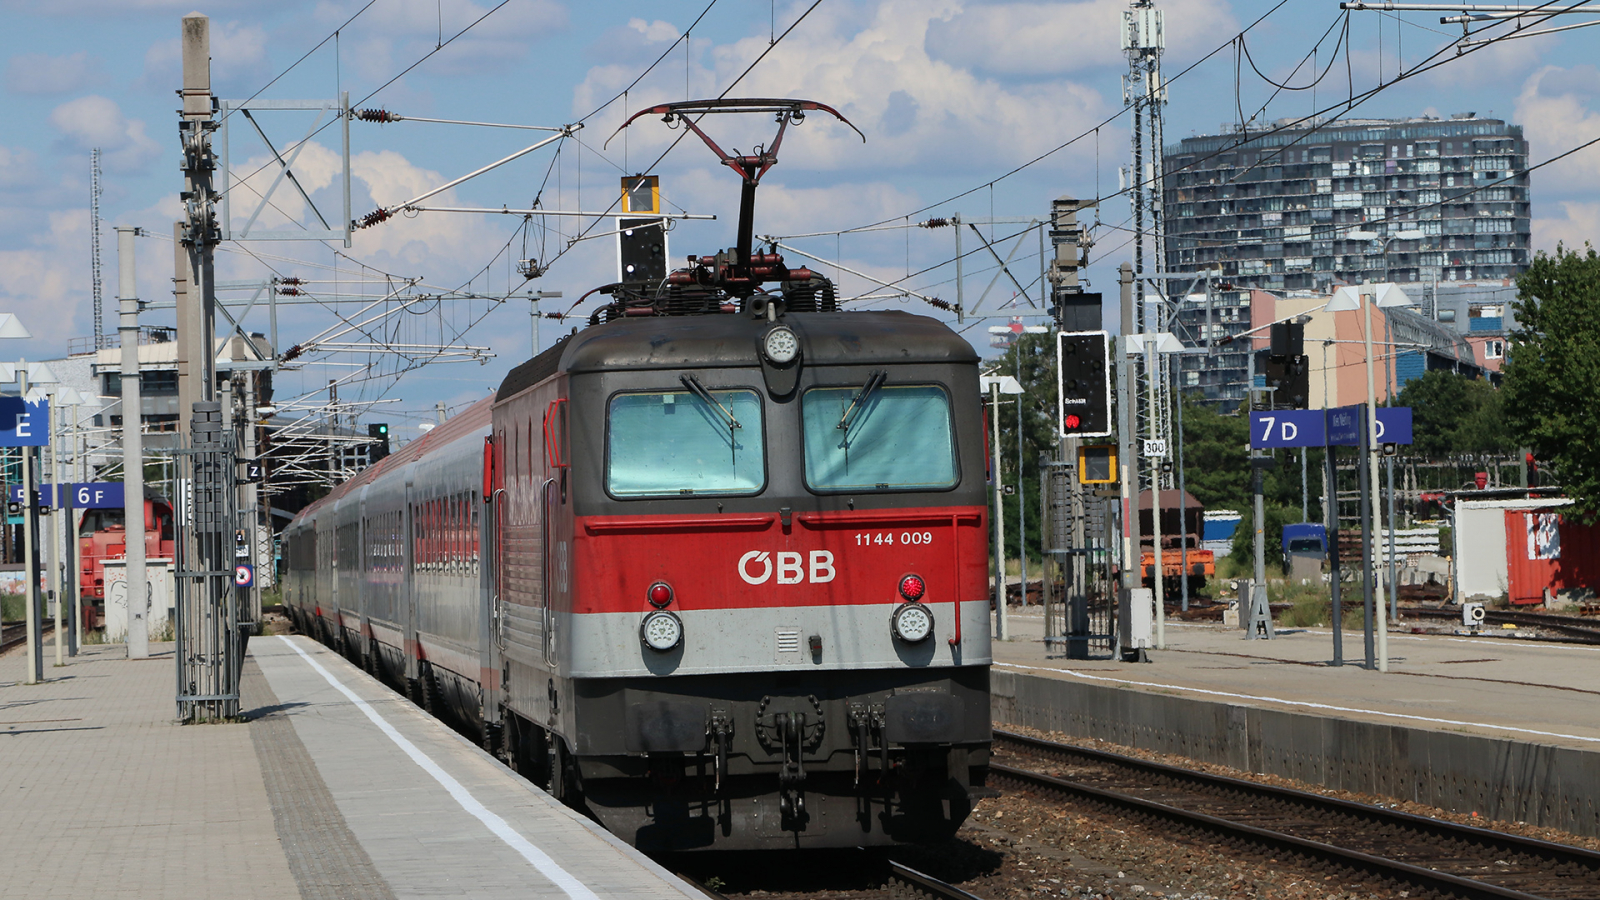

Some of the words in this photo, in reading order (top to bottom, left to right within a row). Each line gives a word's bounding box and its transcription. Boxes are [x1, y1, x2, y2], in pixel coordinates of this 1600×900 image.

[16, 413, 31, 437] E
[1259, 416, 1275, 442] 7
[1281, 421, 1298, 441] D
[1146, 443, 1164, 453] 300
[250, 466, 258, 476] Z
[78, 487, 90, 503] 6
[95, 490, 103, 504] F
[855, 533, 894, 546] 1144
[900, 532, 932, 545] 009
[738, 550, 836, 585] ÖBB
